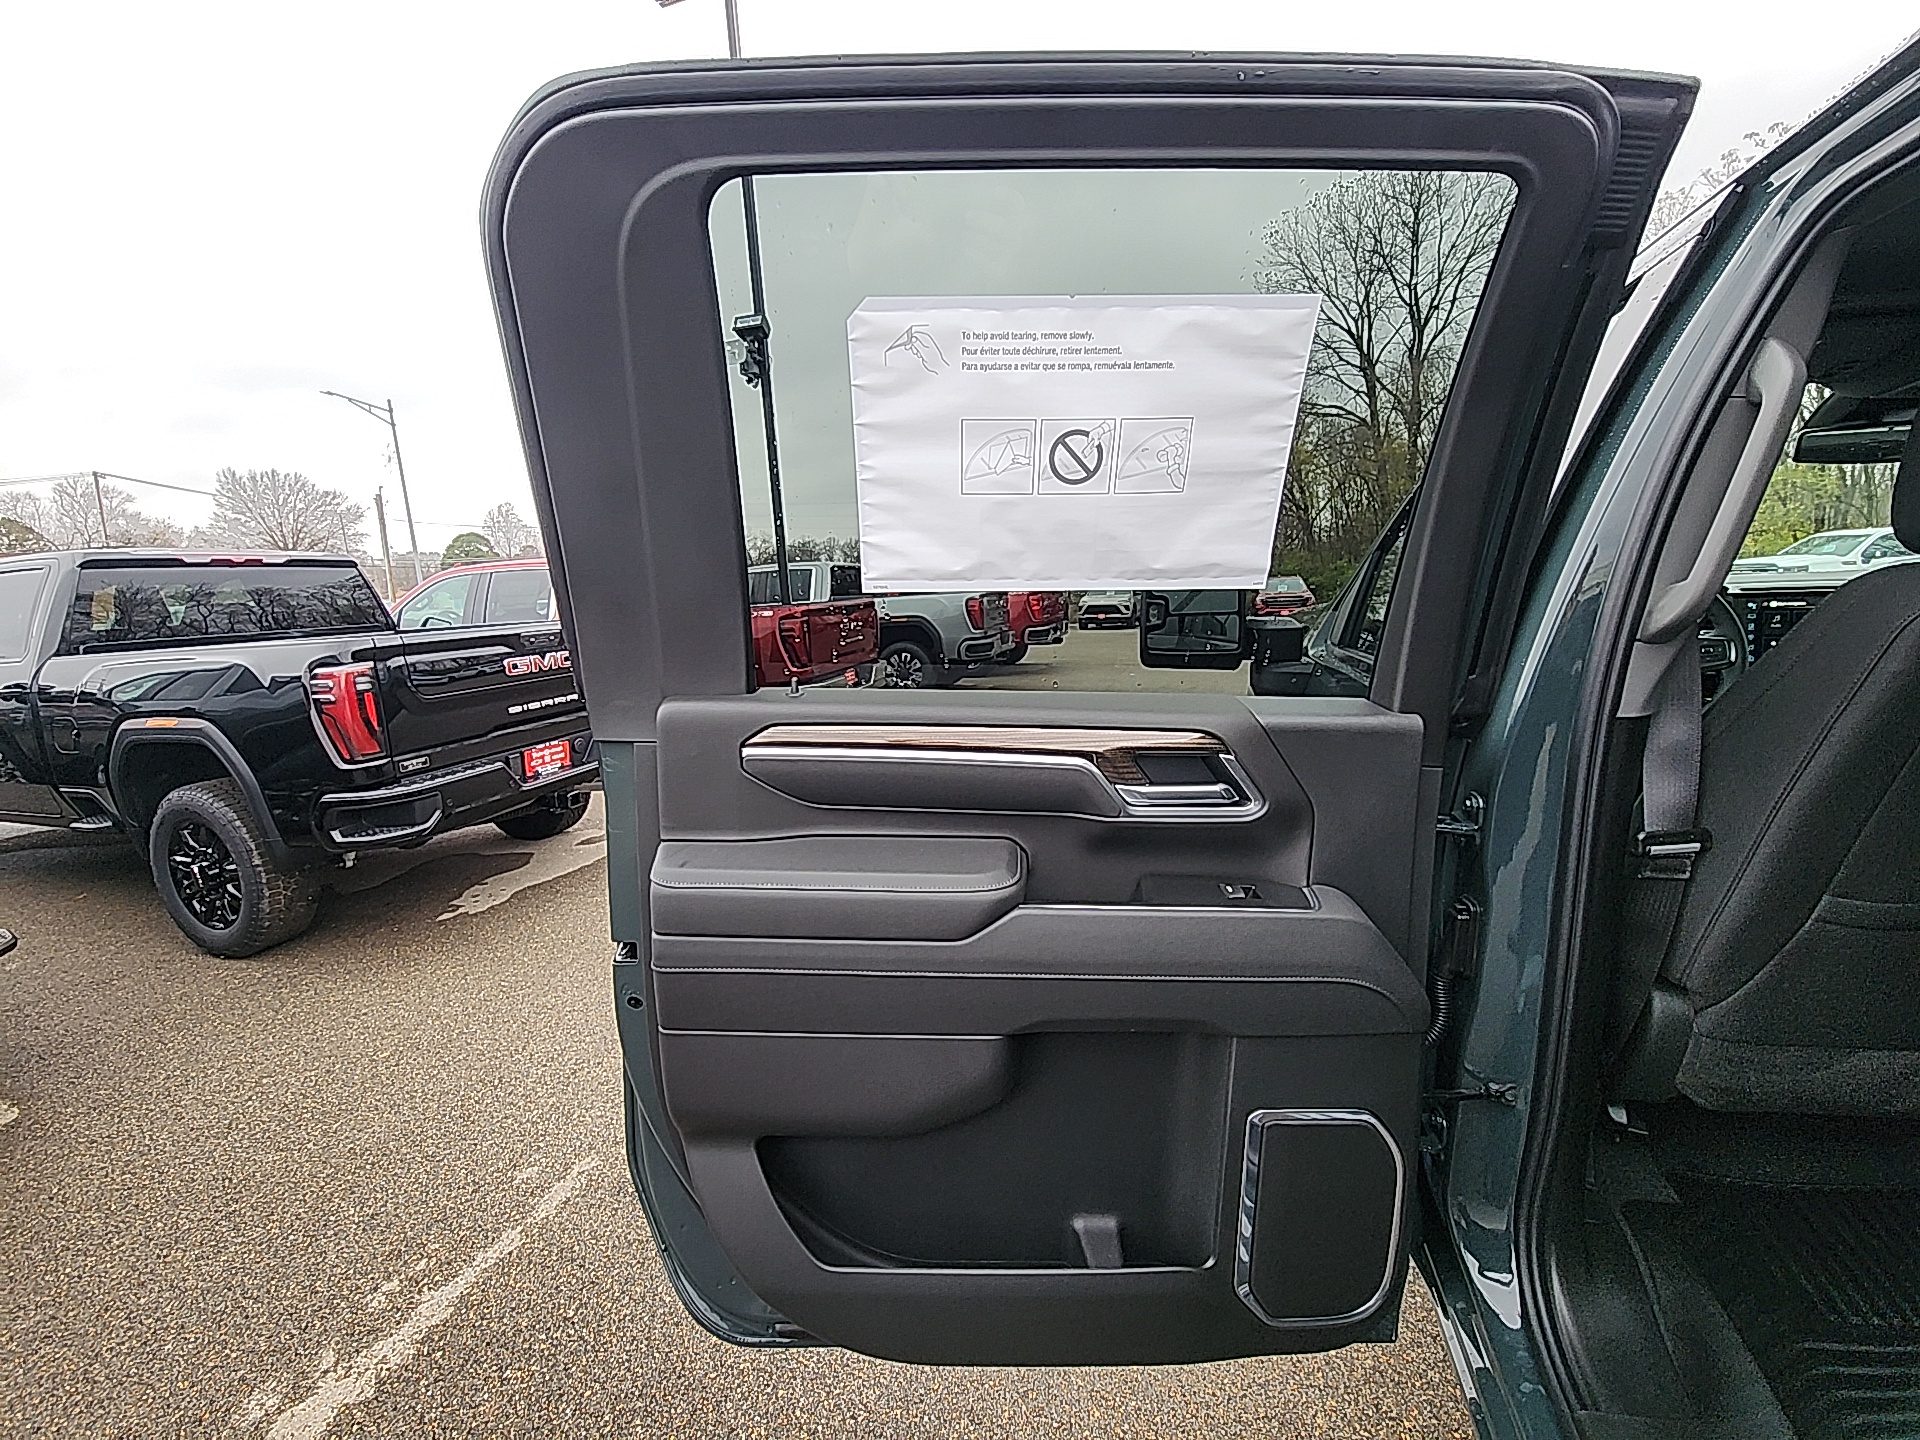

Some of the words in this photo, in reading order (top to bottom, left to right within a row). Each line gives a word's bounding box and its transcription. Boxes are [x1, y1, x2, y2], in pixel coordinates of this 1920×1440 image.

[961, 331, 971, 340] To
[973, 331, 988, 342] help
[990, 331, 1009, 340] avoid
[1011, 331, 1039, 342] tearing,
[1041, 332, 1067, 340] remove
[1069, 331, 1094, 341] slowly.
[961, 346, 978, 355] Pour
[980, 346, 1000, 355] éviter
[1002, 347, 1020, 355] toute
[1022, 346, 1058, 356] déchirure,
[1060, 346, 1082, 355] retirer
[1084, 346, 1122, 355] lentement.
[961, 362, 978, 370] Para
[980, 362, 1012, 372] ayudarse
[1020, 362, 1040, 370] evitar
[1042, 363, 1055, 372] que
[1068, 363, 1092, 371] rompa,
[1094, 361, 1131, 370] remuévala
[1133, 361, 1175, 370] lentamente.
[503, 651, 572, 676] GMC
[508, 694, 578, 714] SIERRA
